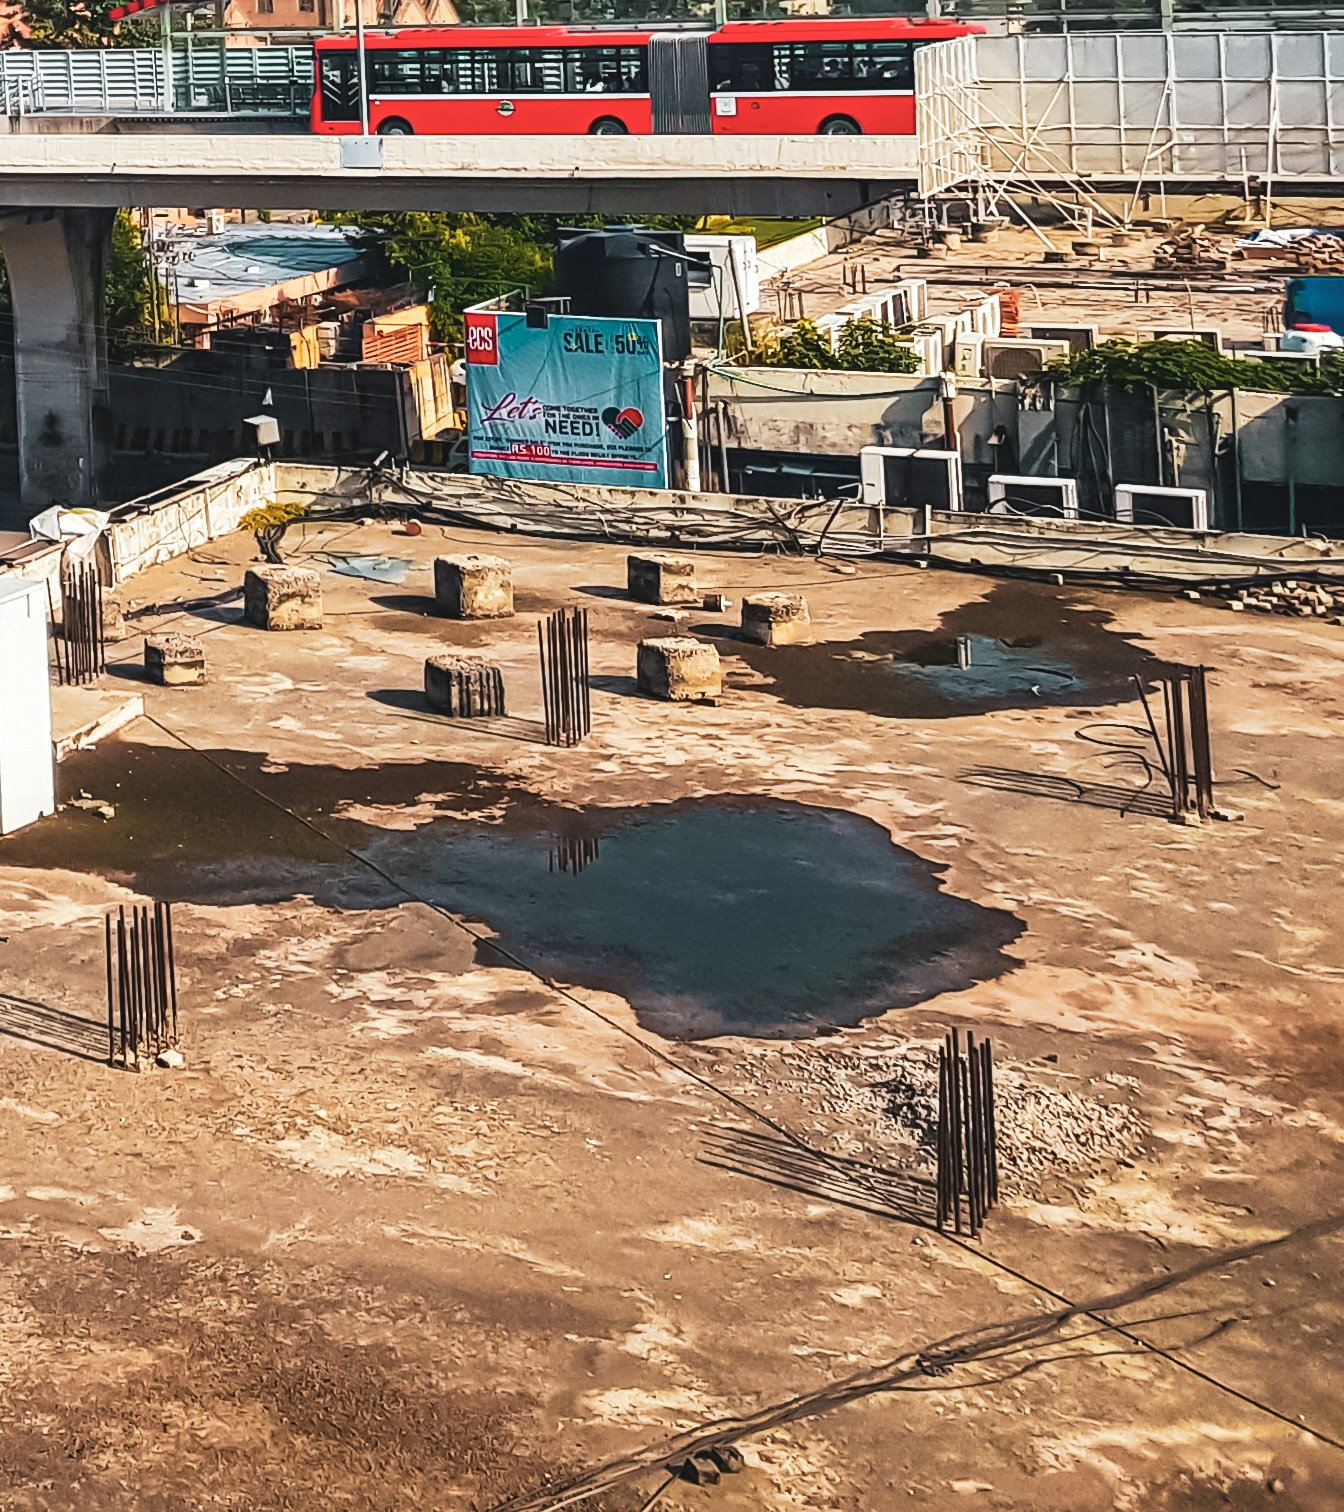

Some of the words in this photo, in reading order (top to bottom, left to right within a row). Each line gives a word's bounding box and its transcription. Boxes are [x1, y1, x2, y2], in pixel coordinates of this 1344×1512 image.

[564, 332, 604, 354] SALE
[480, 392, 542, 425] Let's
[544, 419, 600, 437] NEED!
[512, 444, 527, 454] RS
[531, 445, 550, 456] 100
